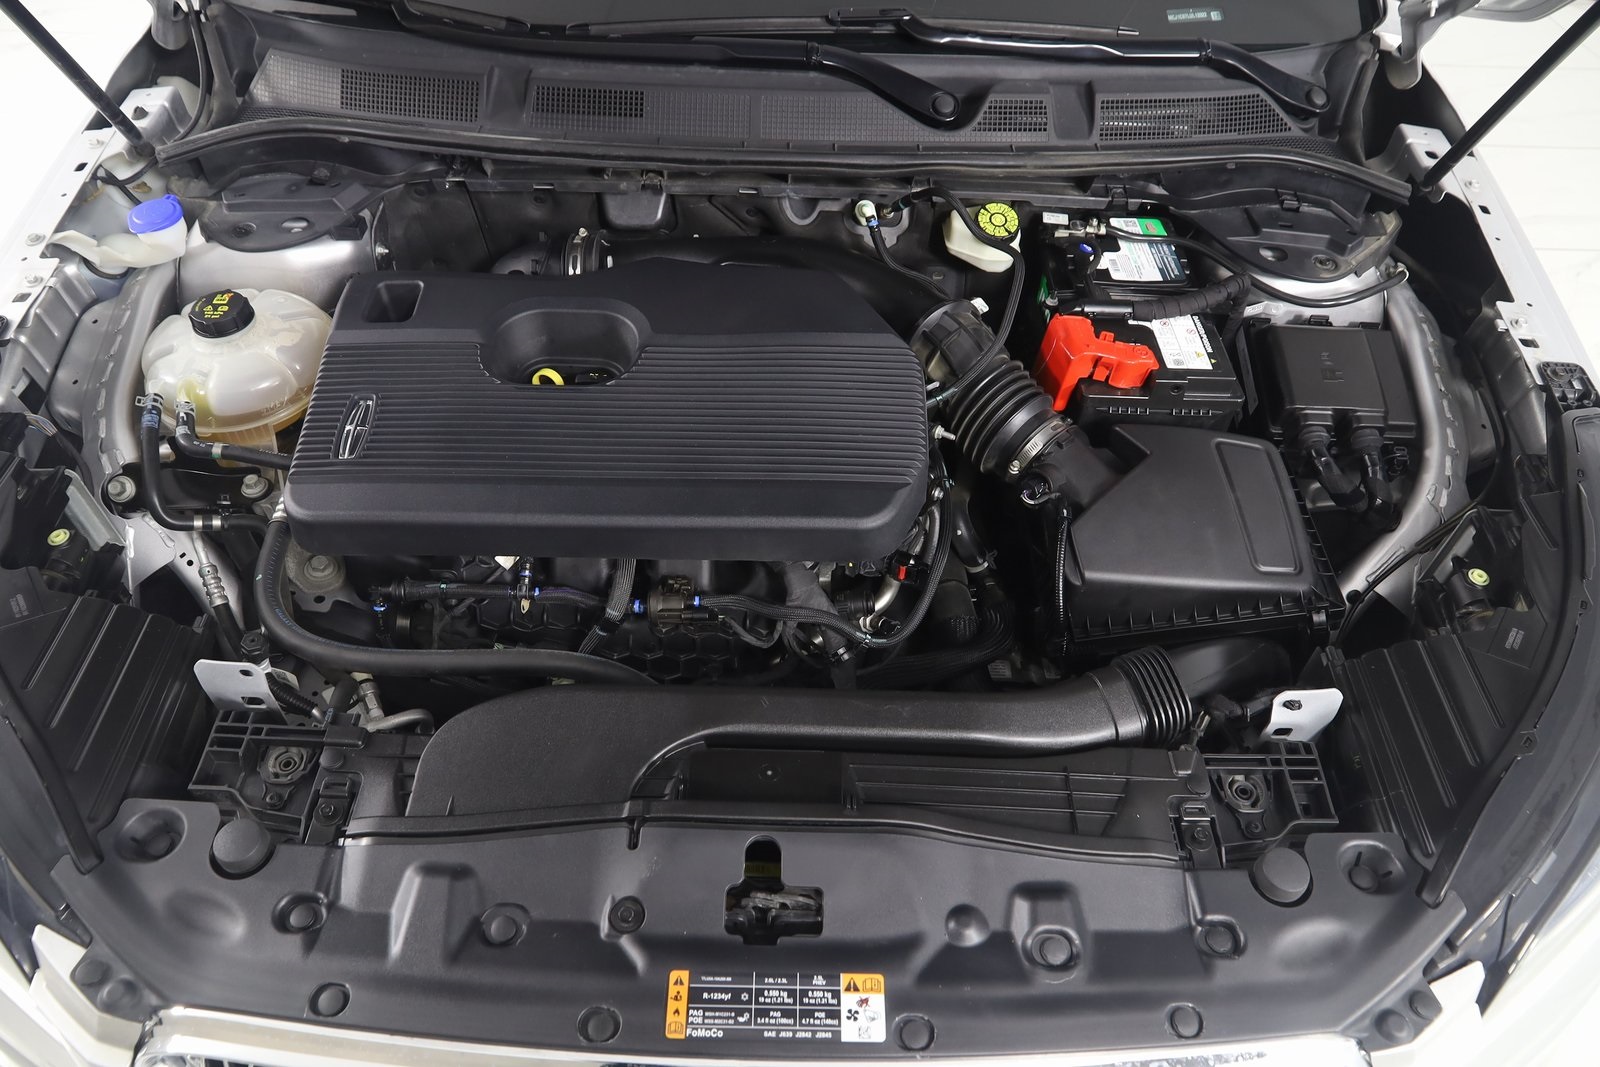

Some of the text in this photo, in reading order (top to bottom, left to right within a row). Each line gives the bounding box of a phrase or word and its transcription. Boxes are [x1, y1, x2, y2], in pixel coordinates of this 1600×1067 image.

[702, 992, 732, 1001] R-1234yf
[780, 990, 788, 998] kg
[824, 991, 832, 999] kg
[688, 1016, 703, 1024] POE
[686, 1028, 723, 1037] FoMoCo
